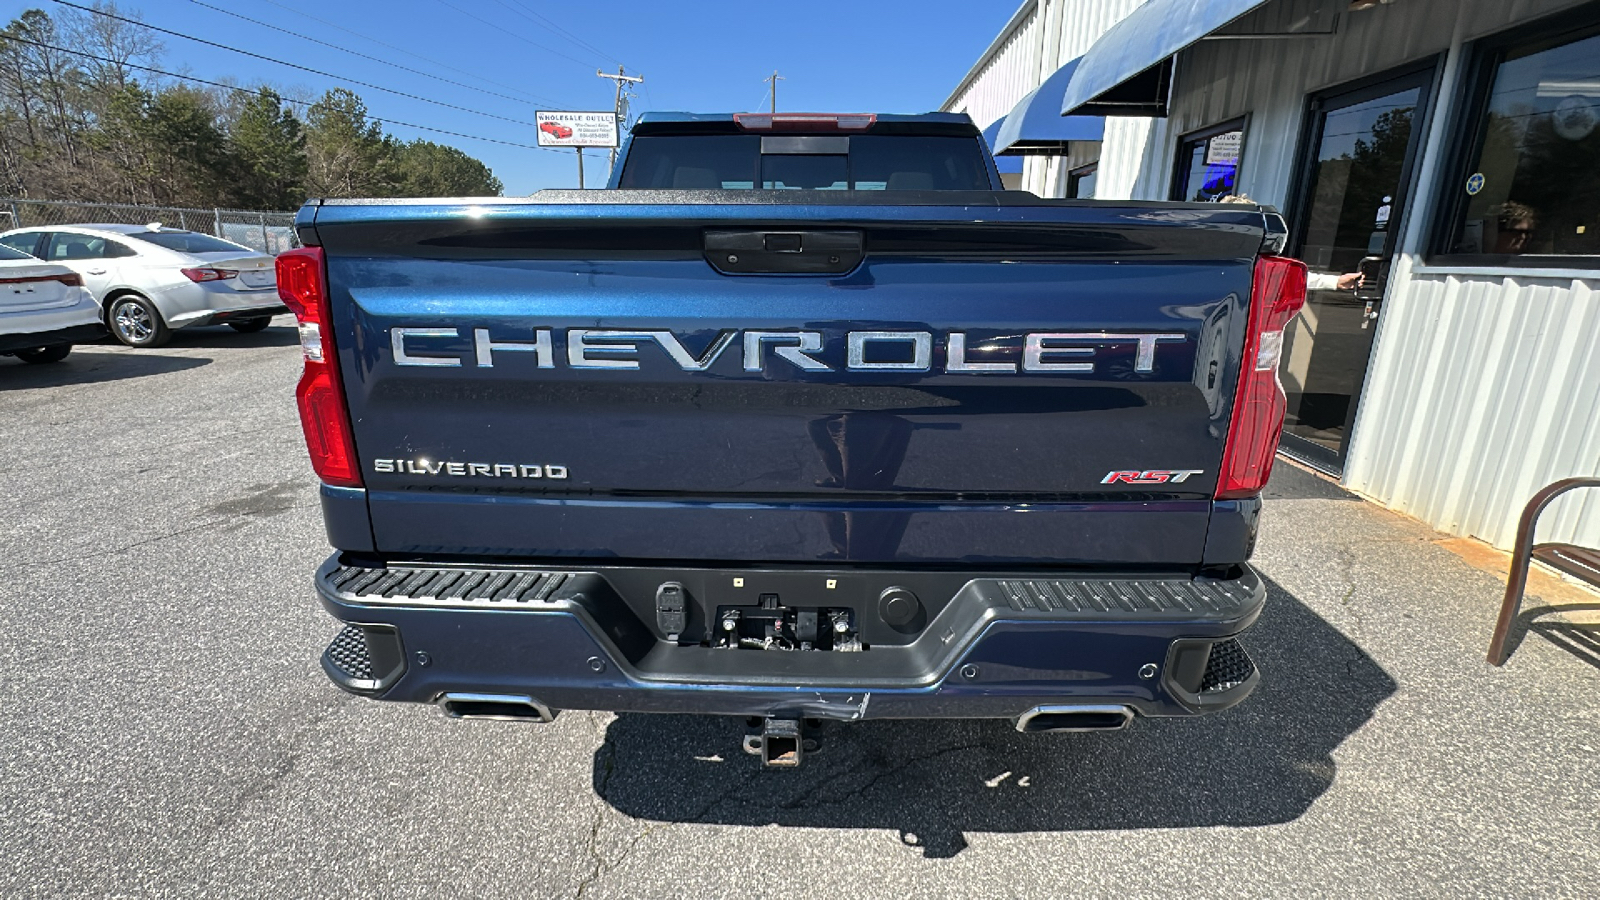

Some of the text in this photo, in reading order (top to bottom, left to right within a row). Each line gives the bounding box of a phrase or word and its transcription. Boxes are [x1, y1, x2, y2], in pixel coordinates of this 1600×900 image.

[391, 326, 1188, 373] CHEVROLET
[374, 458, 568, 479] SILVERADO
[1100, 469, 1204, 484] RST
